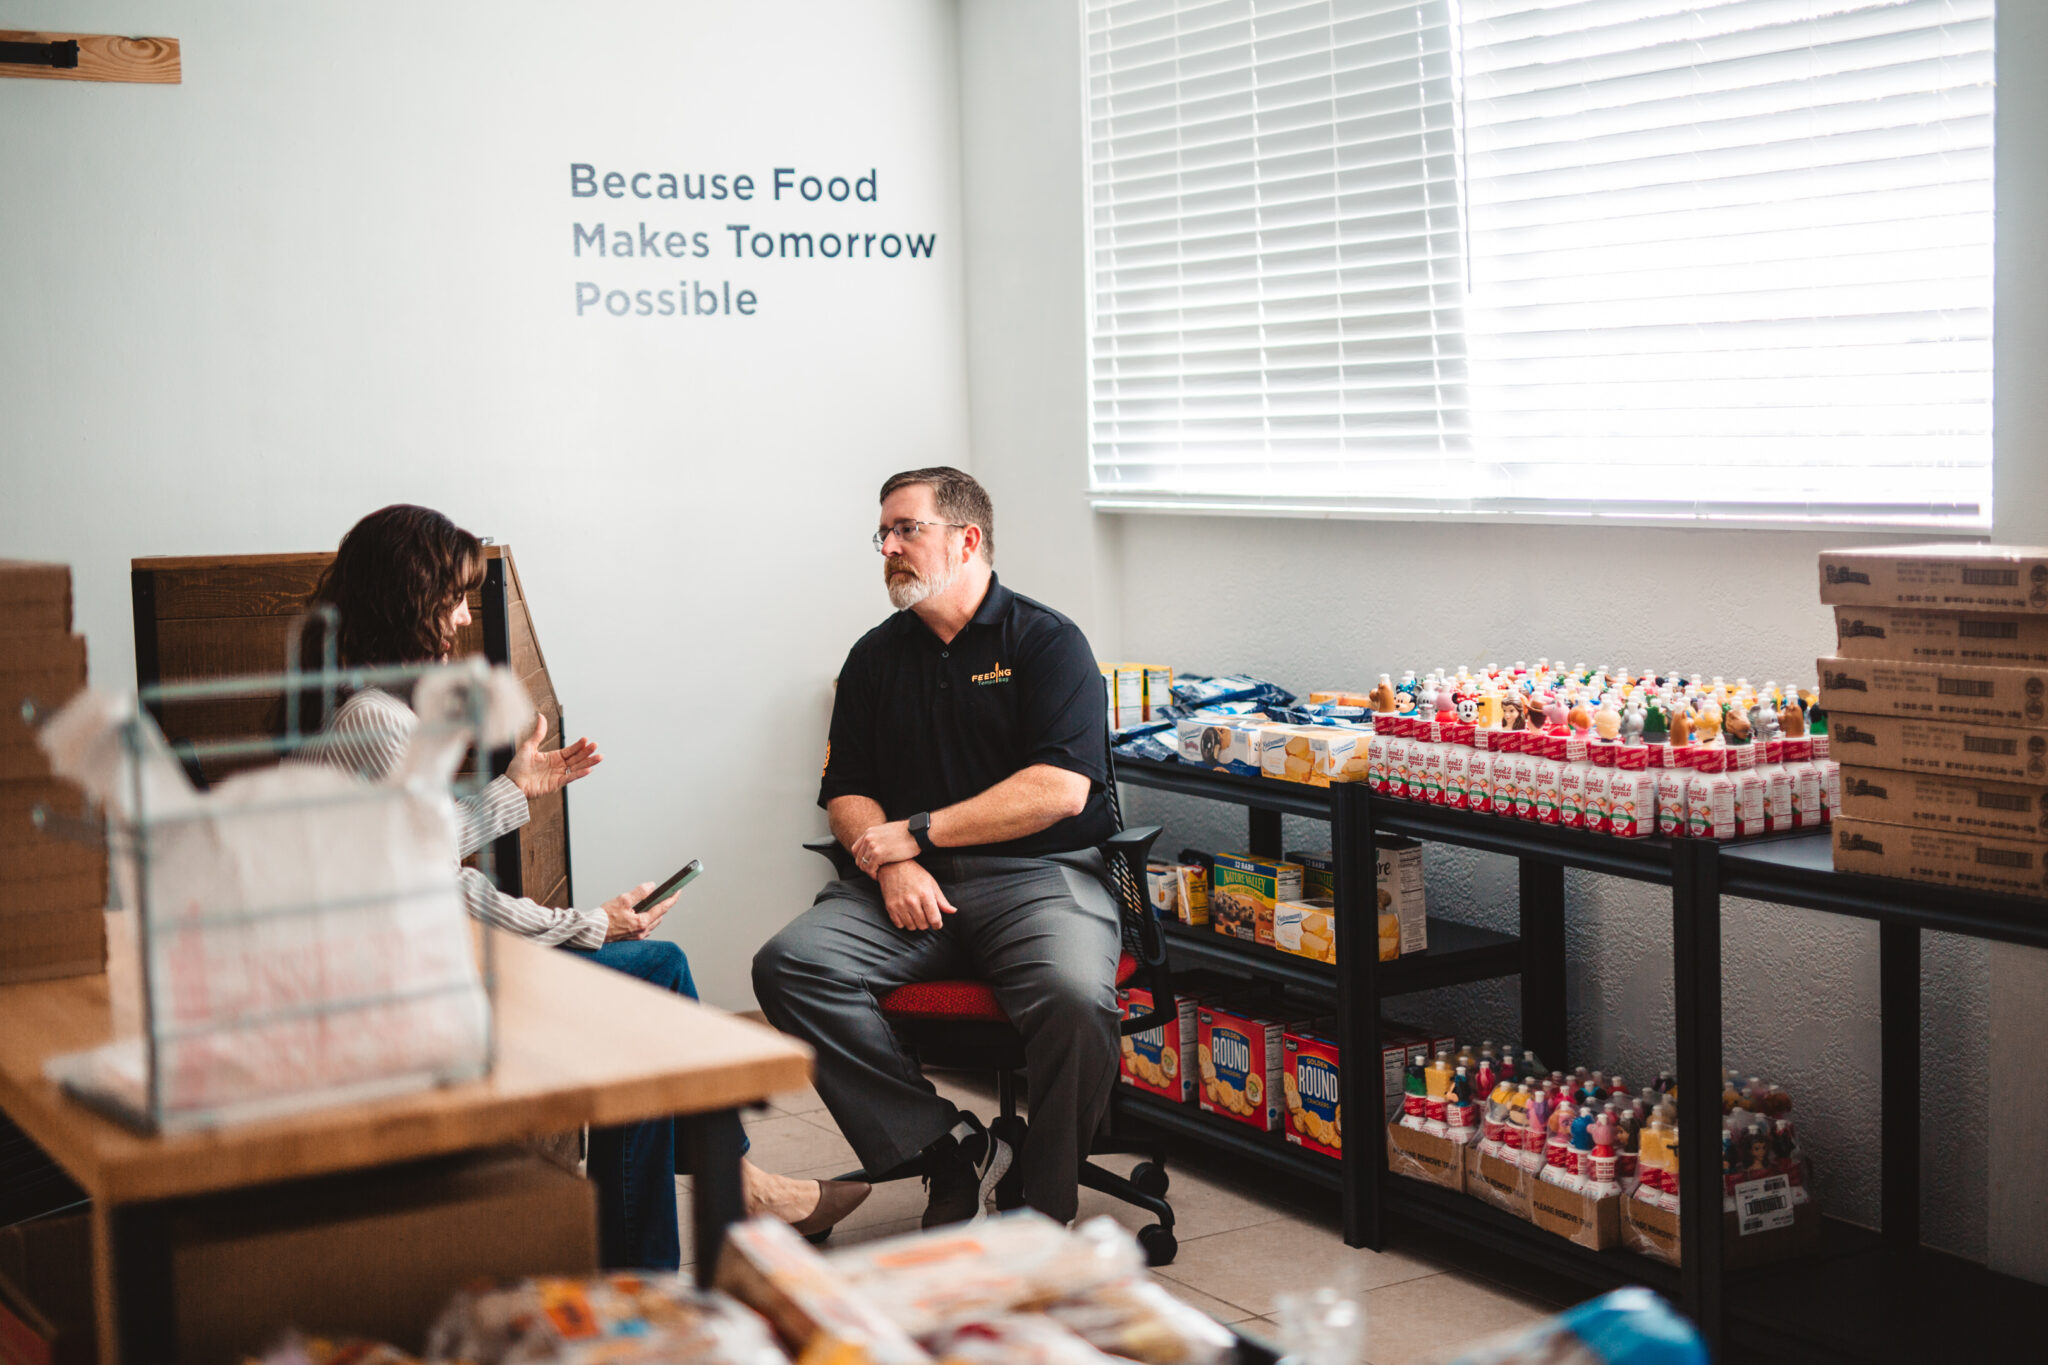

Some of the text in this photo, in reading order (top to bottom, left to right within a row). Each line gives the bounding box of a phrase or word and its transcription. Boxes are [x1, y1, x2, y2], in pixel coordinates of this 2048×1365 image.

[570, 163, 878, 201] Because Food
[573, 222, 936, 258] Makes Tomorrow
[575, 281, 758, 316] Possible
[1221, 1030, 1241, 1041] GOLDEN
[1213, 1036, 1249, 1073] ROUND
[1306, 1058, 1329, 1070] GOLDEN
[1298, 1064, 1338, 1103] ROUND
[1533, 1200, 1554, 1215] PLEASE
[1555, 1207, 1578, 1223] REMOVE
